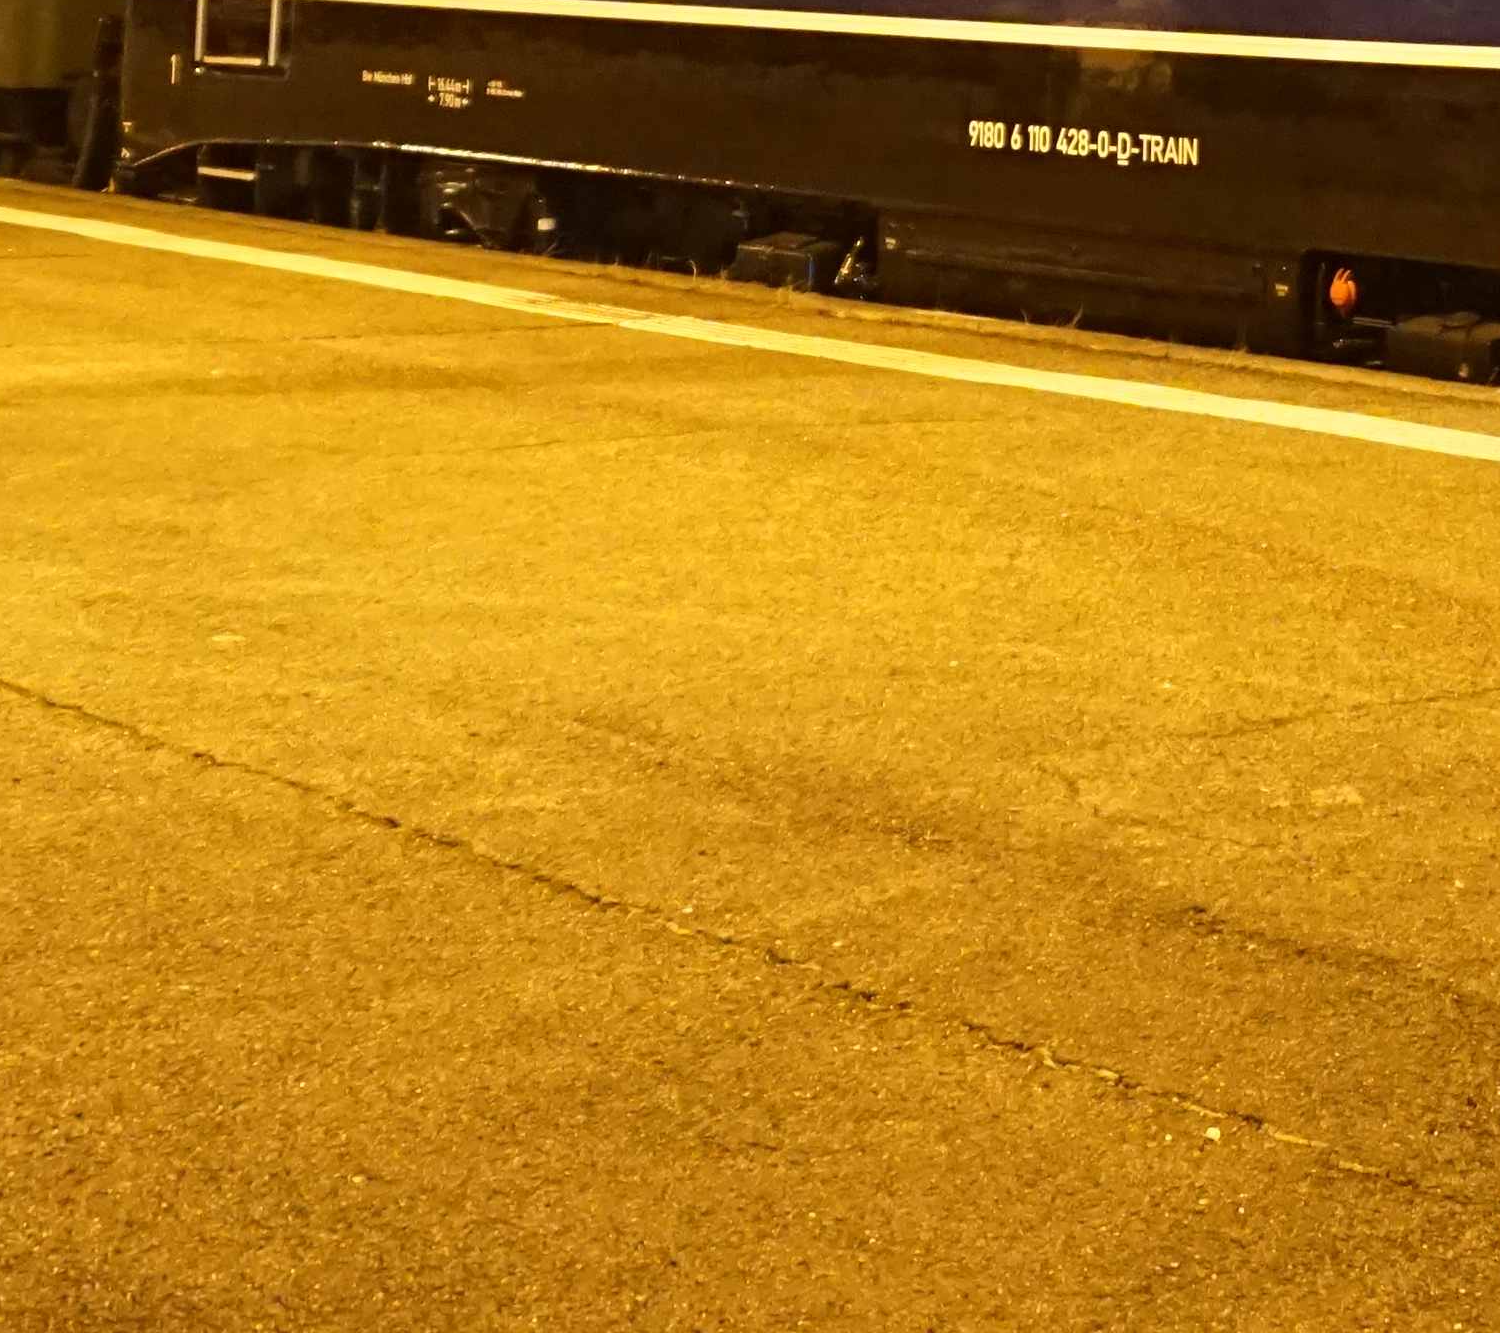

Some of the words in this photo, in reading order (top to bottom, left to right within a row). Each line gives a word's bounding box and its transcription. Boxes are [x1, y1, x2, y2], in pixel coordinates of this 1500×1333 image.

[969, 120, 1005, 149] 9180
[1010, 123, 1022, 150] 6
[1027, 124, 1050, 153] 110
[1056, 127, 1198, 166] 428-0-D-TRAIN
